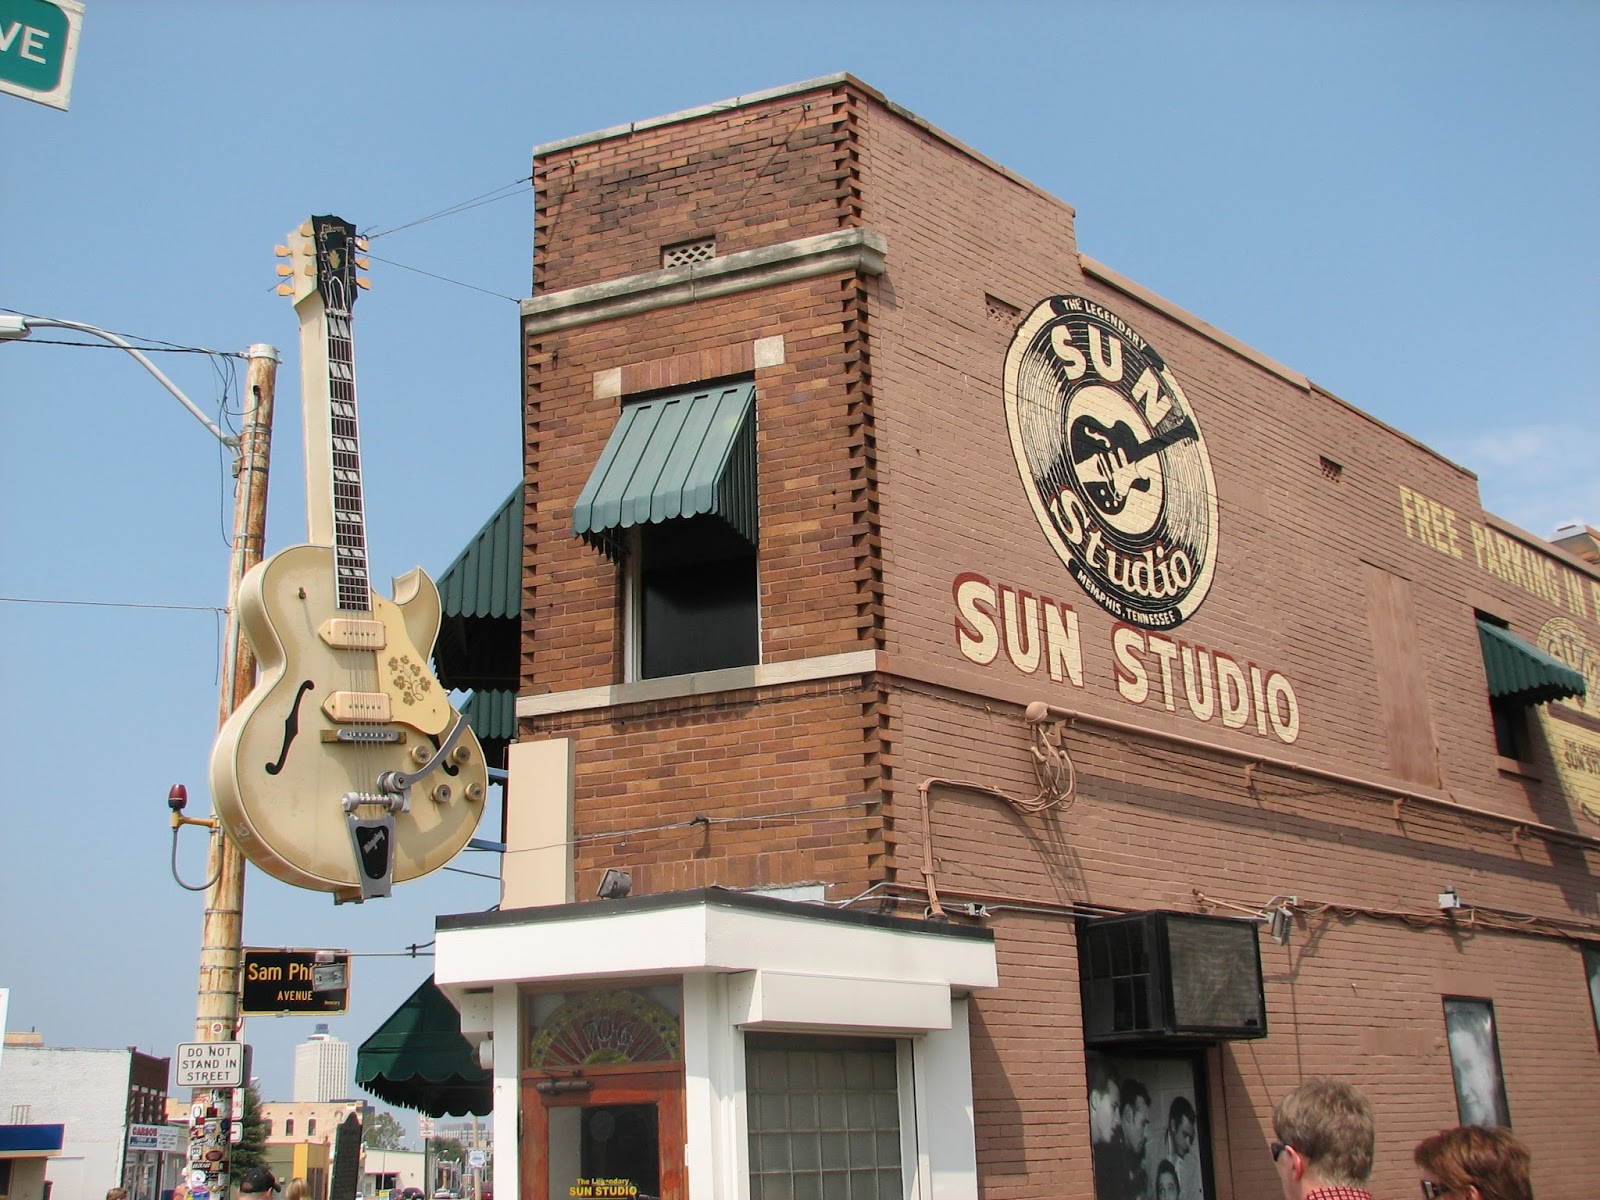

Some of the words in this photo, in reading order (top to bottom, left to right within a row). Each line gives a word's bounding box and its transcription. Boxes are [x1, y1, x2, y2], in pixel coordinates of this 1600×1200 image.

[1062, 298, 1082, 311] THE
[1084, 300, 1147, 350] LEGENDARY
[1051, 324, 1173, 428] SUN
[1050, 489, 1192, 599] Studio
[1399, 485, 1463, 560] FREE
[1470, 520, 1561, 608] PARKING
[1563, 567, 1588, 619] IN
[1127, 609, 1177, 626] TENNESSEE
[953, 571, 1085, 689] SUN
[1111, 621, 1300, 745] STUDIO
[248, 963, 282, 980] Sam
[277, 990, 313, 1001] AVENUE
[188, 1048, 203, 1057] DO
[209, 1047, 231, 1057] NOT
[182, 1060, 219, 1069] STAND
[225, 1059, 237, 1068] IN
[187, 1072, 230, 1081] STREET
[569, 1187, 592, 1196] SUN
[595, 1186, 637, 1196] STUDIO
